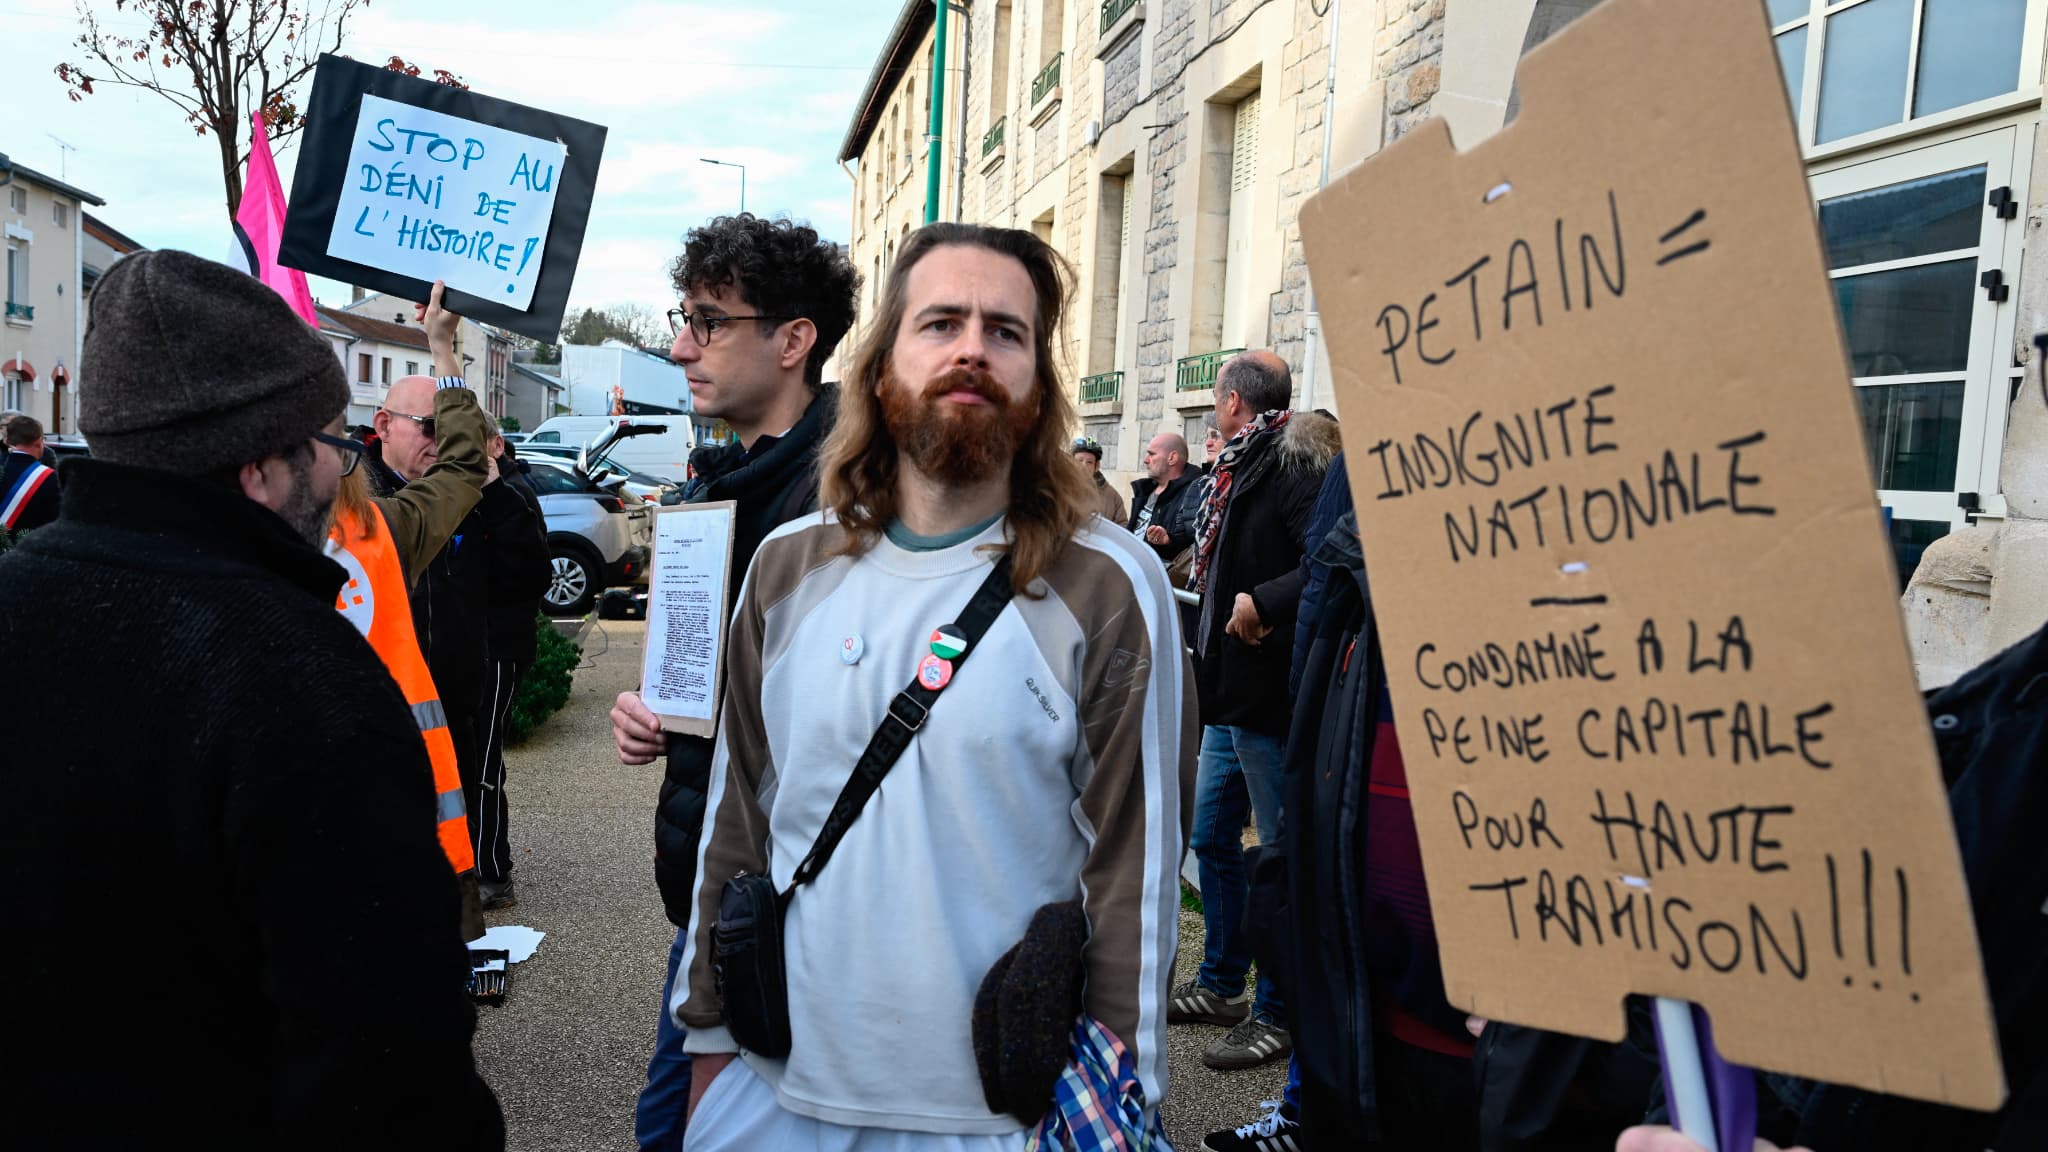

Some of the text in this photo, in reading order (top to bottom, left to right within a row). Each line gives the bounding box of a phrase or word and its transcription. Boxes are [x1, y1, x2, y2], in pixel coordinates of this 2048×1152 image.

[367, 118, 554, 193] STOP AU
[473, 190, 517, 225] DE
[1375, 190, 1625, 384] PETAIN
[1368, 385, 1618, 500] INDIGNITE
[1445, 431, 1776, 563] NATIONALE
[1636, 617, 1664, 676] A
[1687, 615, 1753, 674] LA
[1423, 697, 1834, 770] PEINE CAPITALE
[1452, 790, 1795, 878] POUR HAUTE
